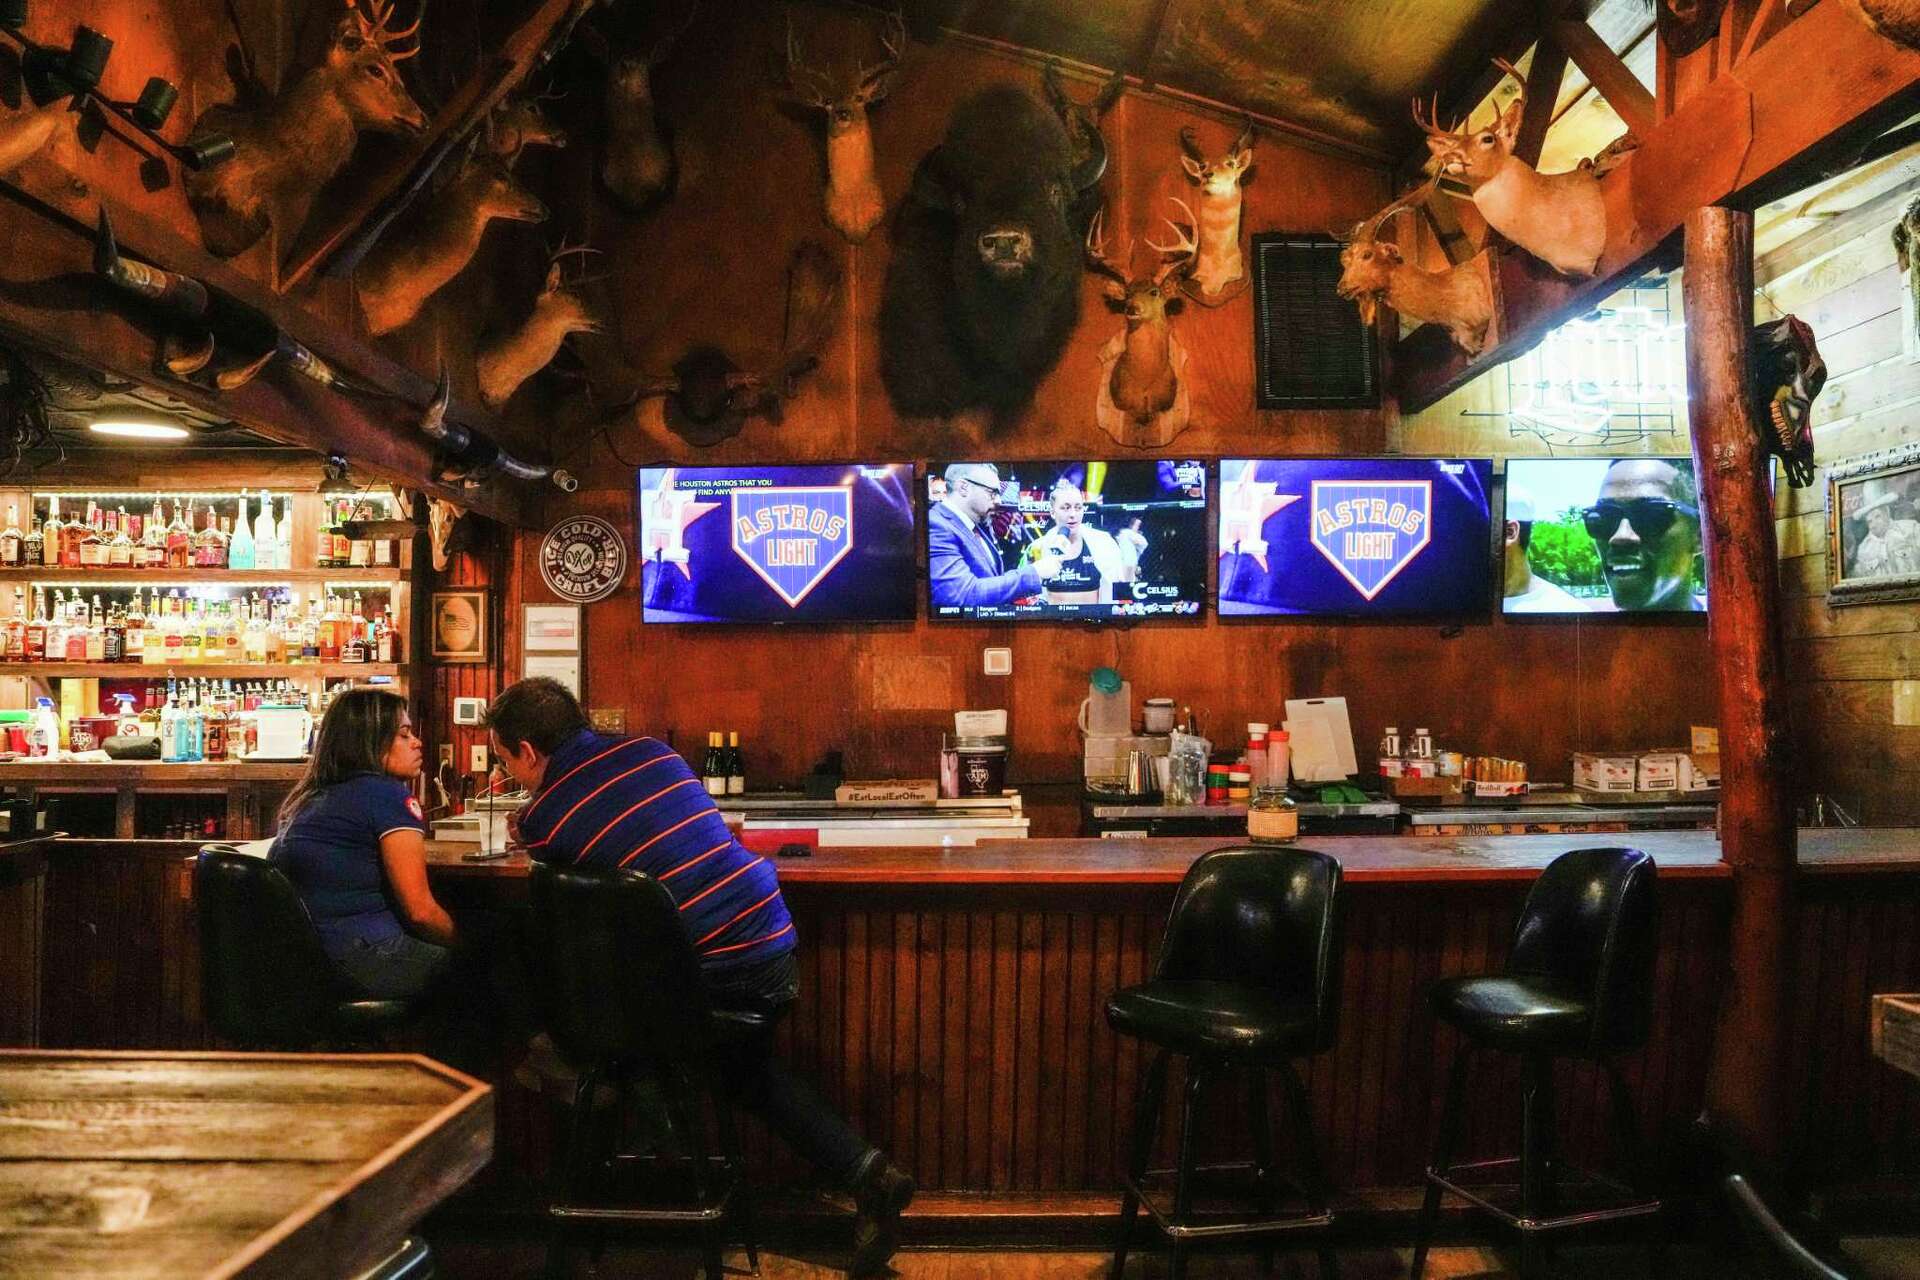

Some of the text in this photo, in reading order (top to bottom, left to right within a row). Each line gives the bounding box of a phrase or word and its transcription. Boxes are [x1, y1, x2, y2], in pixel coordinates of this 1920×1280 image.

[1018, 502, 1051, 511] CELSIU
[1317, 498, 1426, 537] ASTROS
[737, 504, 847, 543] ASTROS
[547, 539, 561, 566] ICE
[561, 524, 602, 539] COLD
[766, 538, 819, 567] LIGHT
[1344, 531, 1396, 560] LIGHT
[555, 573, 602, 593] CRAFT
[600, 537, 617, 578] BEER
[1147, 586, 1179, 594] CELSIUS
[848, 792, 926, 801] #EatLocalEatOften
